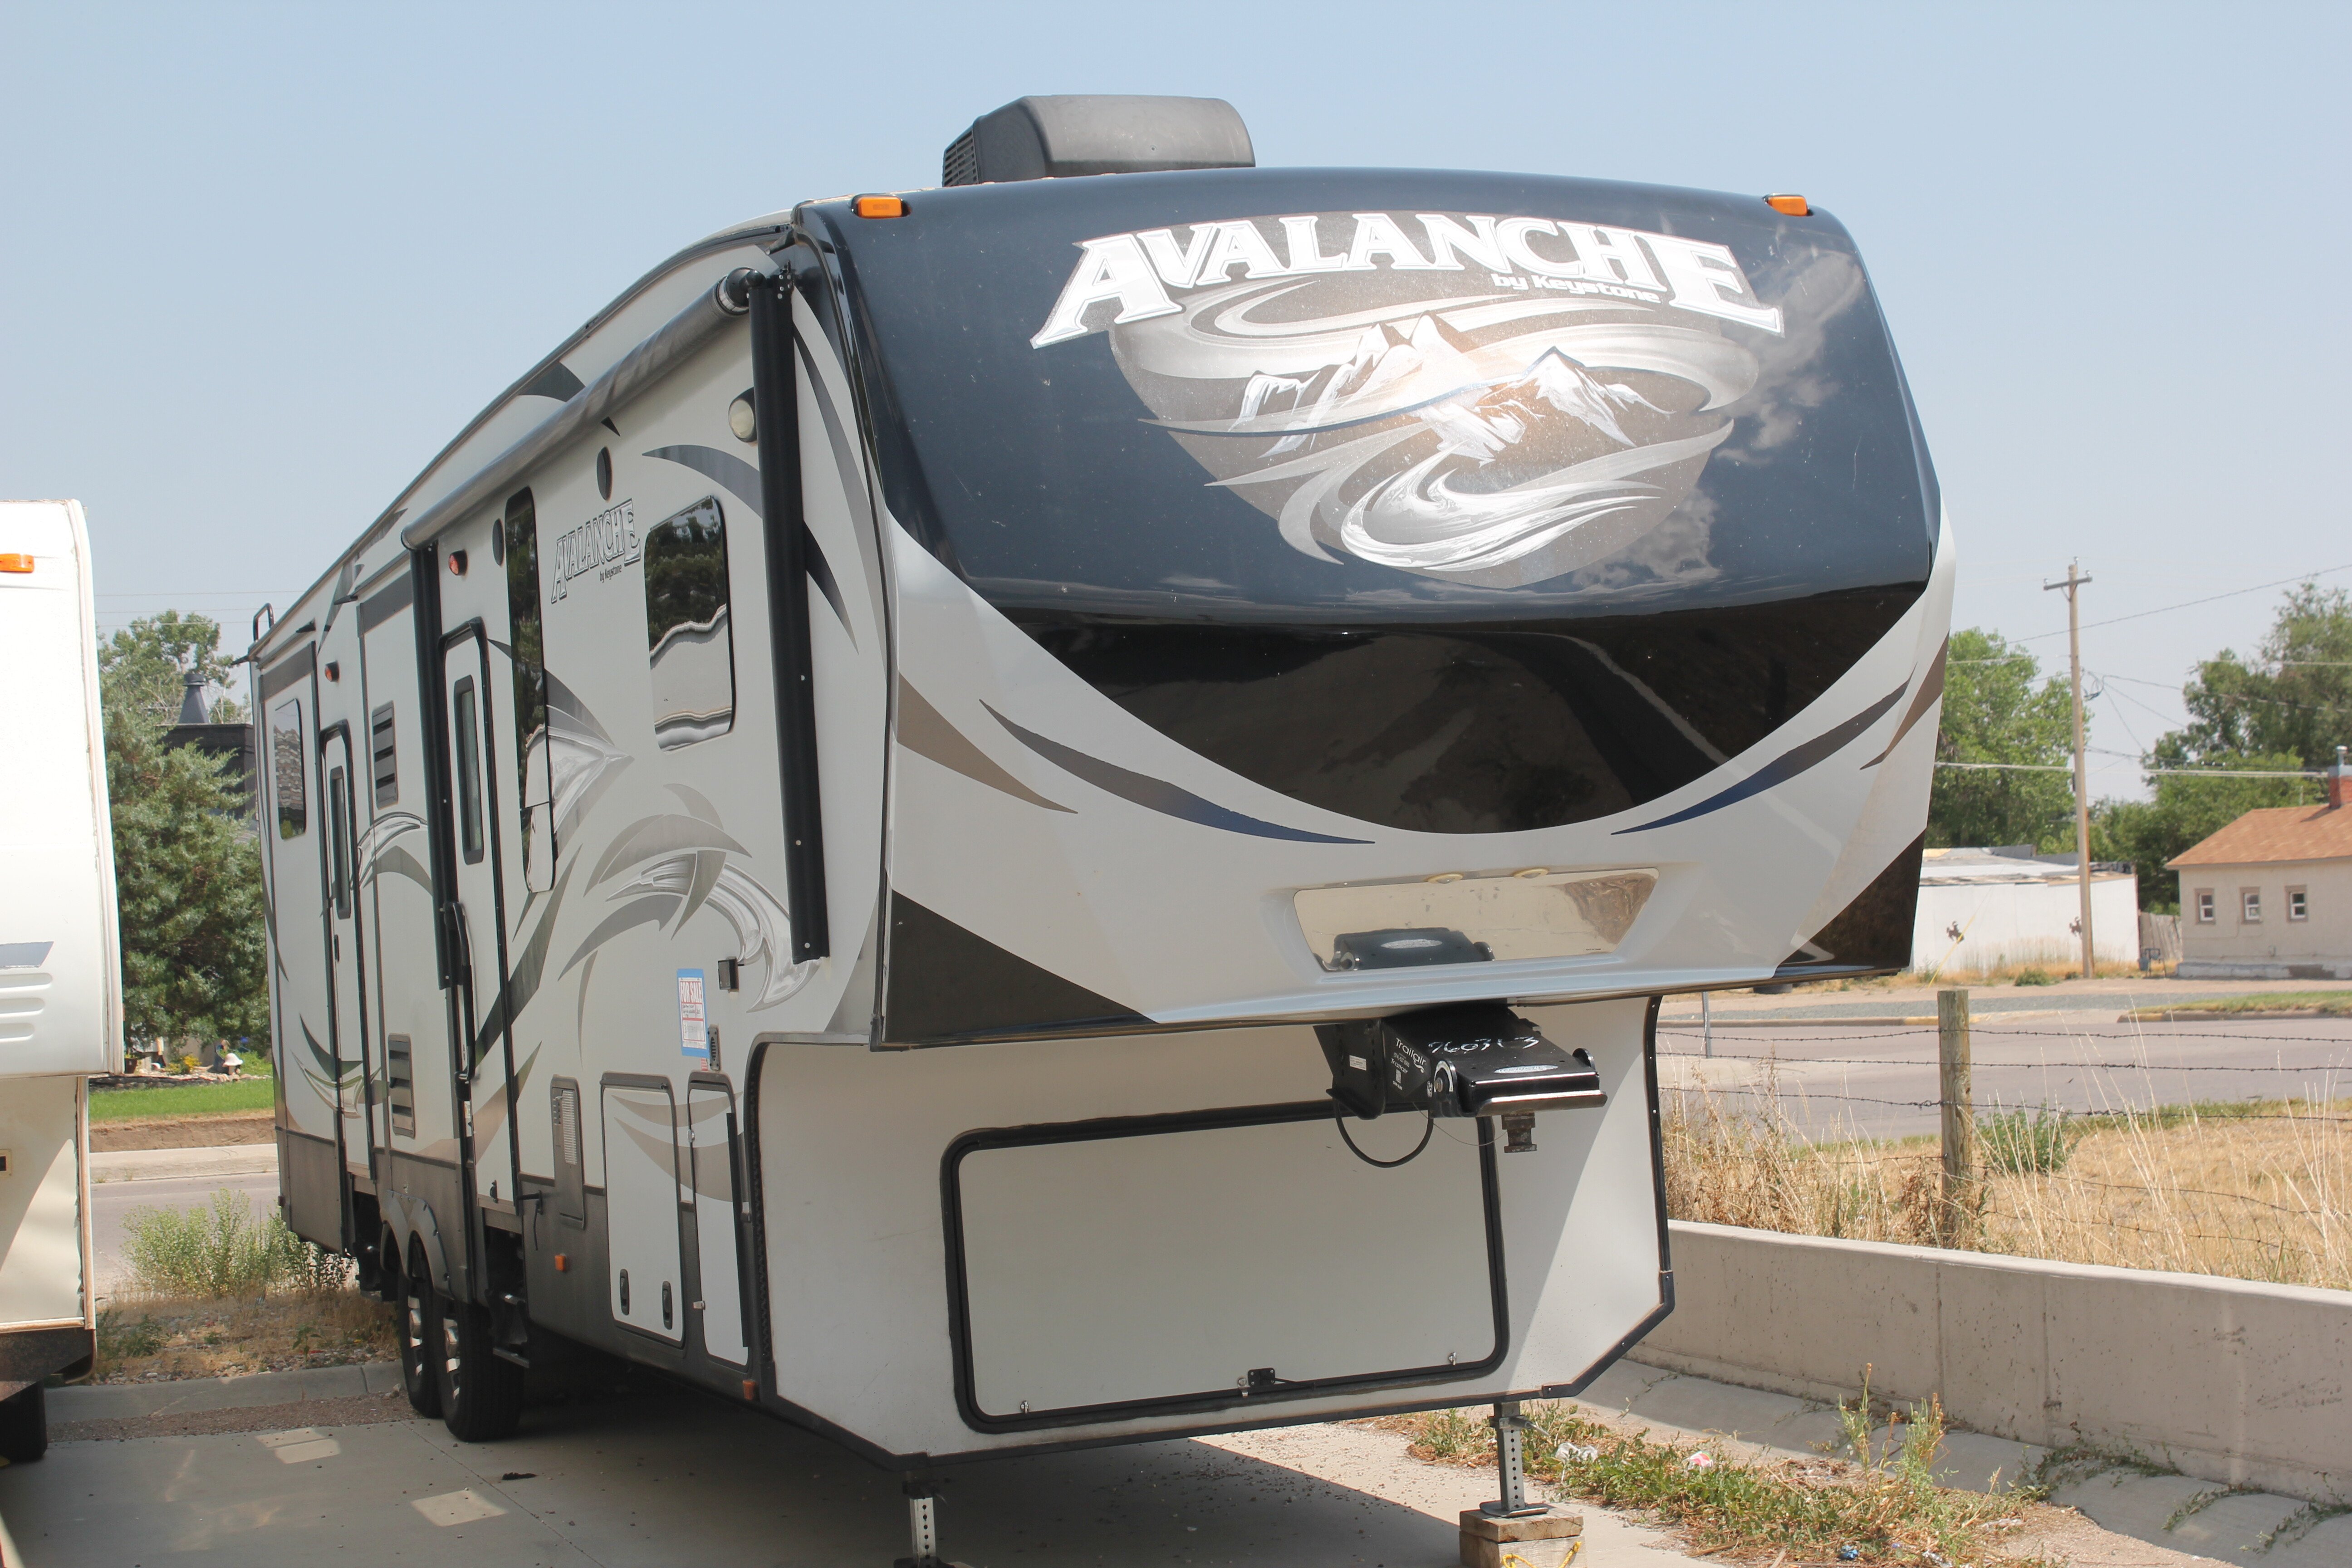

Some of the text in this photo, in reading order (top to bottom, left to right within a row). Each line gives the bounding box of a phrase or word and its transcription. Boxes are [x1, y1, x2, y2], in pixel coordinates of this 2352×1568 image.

[1034, 212, 1782, 347] AVALANCHE
[1491, 273, 1661, 304] by Keystone
[551, 498, 641, 604] AVALANCHE
[600, 564, 622, 583] by Keystone
[680, 982, 702, 1004] FOR SALE
[1396, 1037, 1426, 1065] Trailair
[1391, 1058, 1408, 1073] Trailair
